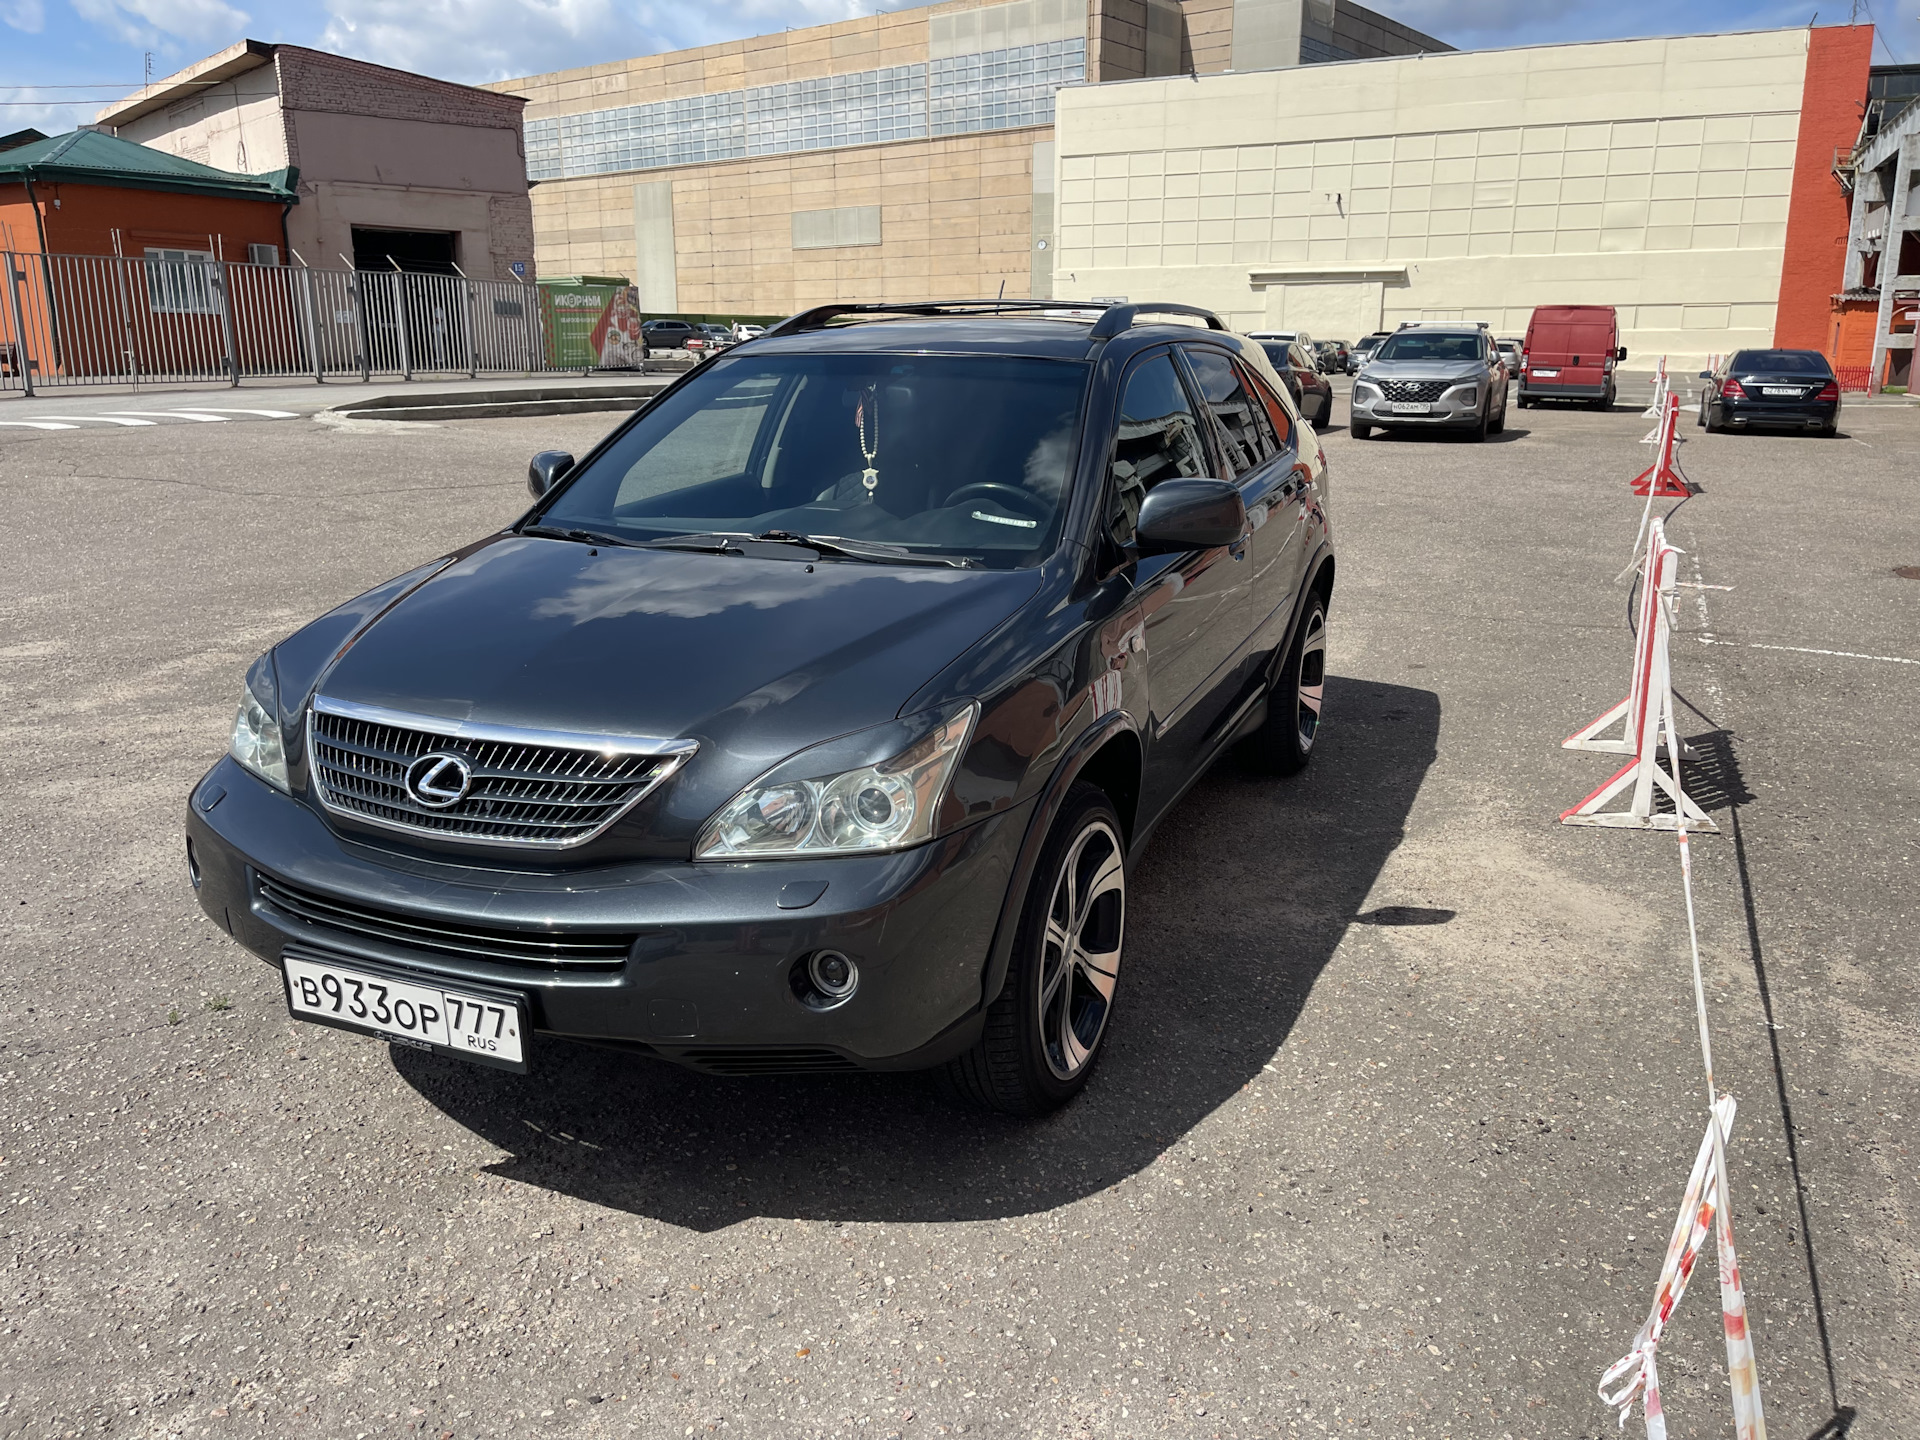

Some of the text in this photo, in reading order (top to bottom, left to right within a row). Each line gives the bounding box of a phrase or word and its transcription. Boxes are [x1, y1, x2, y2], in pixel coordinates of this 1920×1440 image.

[514, 264, 523, 272] 15
[446, 998, 506, 1039] 777
[467, 1034, 498, 1052] RUS
